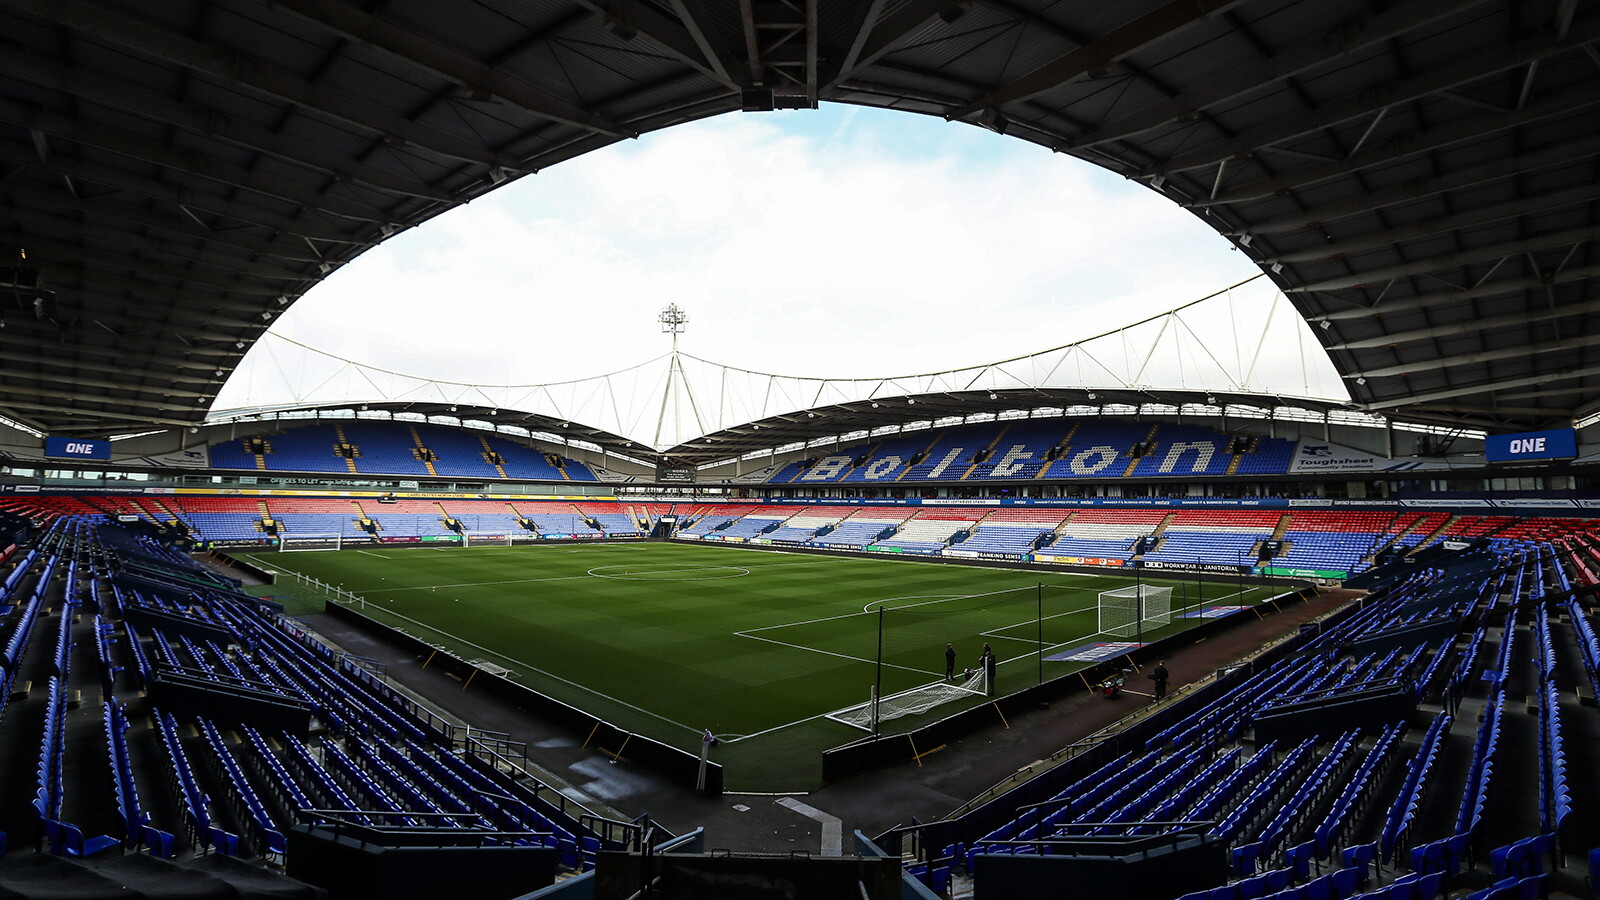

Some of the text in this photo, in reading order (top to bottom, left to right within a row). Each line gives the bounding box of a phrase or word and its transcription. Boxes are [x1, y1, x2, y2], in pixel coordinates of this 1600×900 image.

[65, 442, 94, 455] ONE
[1509, 437, 1546, 454] ONE
[1299, 457, 1375, 466] Toughsheet
